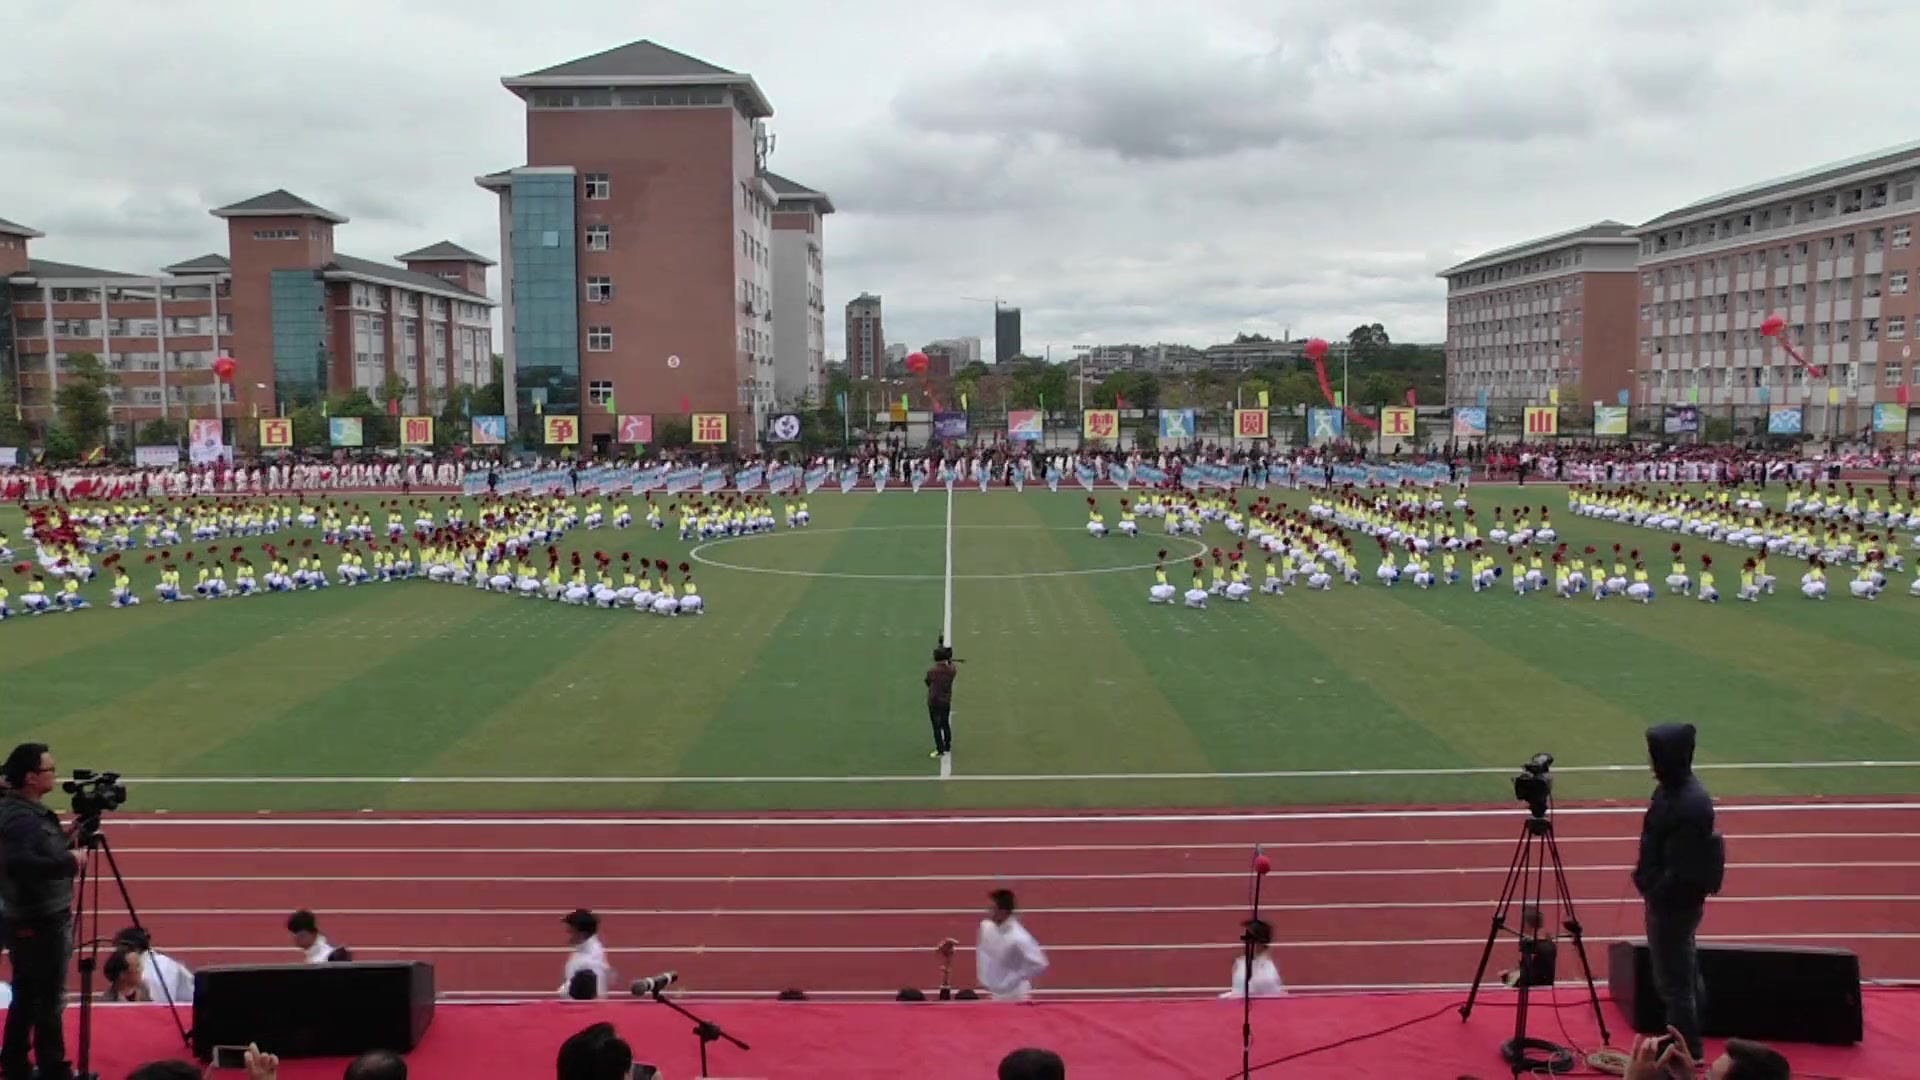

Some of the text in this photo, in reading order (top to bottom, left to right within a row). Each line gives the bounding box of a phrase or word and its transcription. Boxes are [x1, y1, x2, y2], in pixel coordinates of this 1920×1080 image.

[264, 420, 288, 444] 百
[550, 418, 573, 442] 争
[698, 416, 722, 440] 流
[1089, 410, 1553, 436] 梦 圆 玉 山
